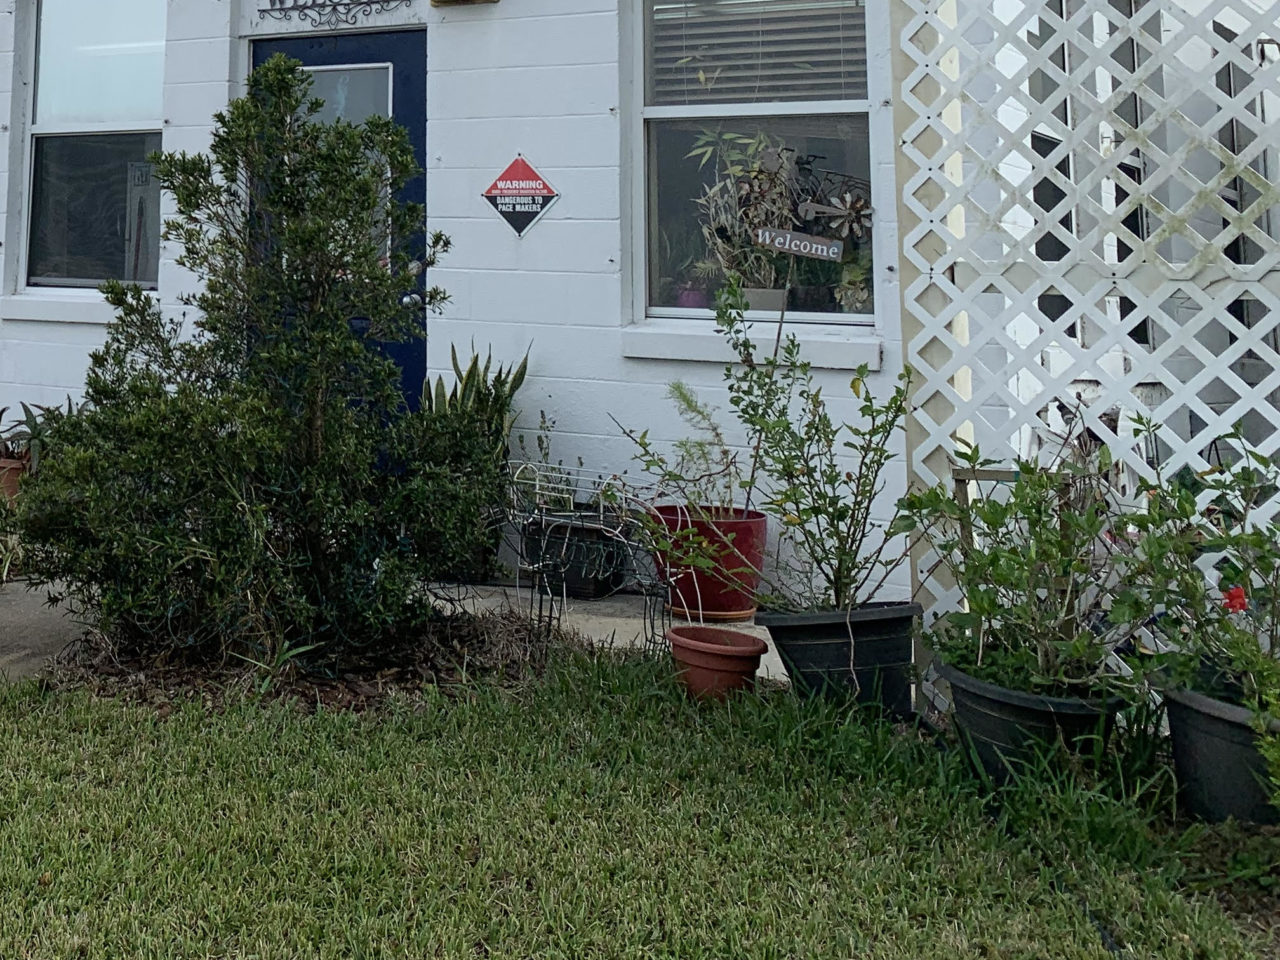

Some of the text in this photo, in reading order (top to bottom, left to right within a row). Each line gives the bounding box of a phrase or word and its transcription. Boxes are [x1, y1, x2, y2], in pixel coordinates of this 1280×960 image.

[496, 180, 543, 189] WARNING
[496, 196, 543, 204] DANGEROUS TO
[498, 204, 541, 212] PACE MAKERS
[757, 229, 839, 259] Welcome
